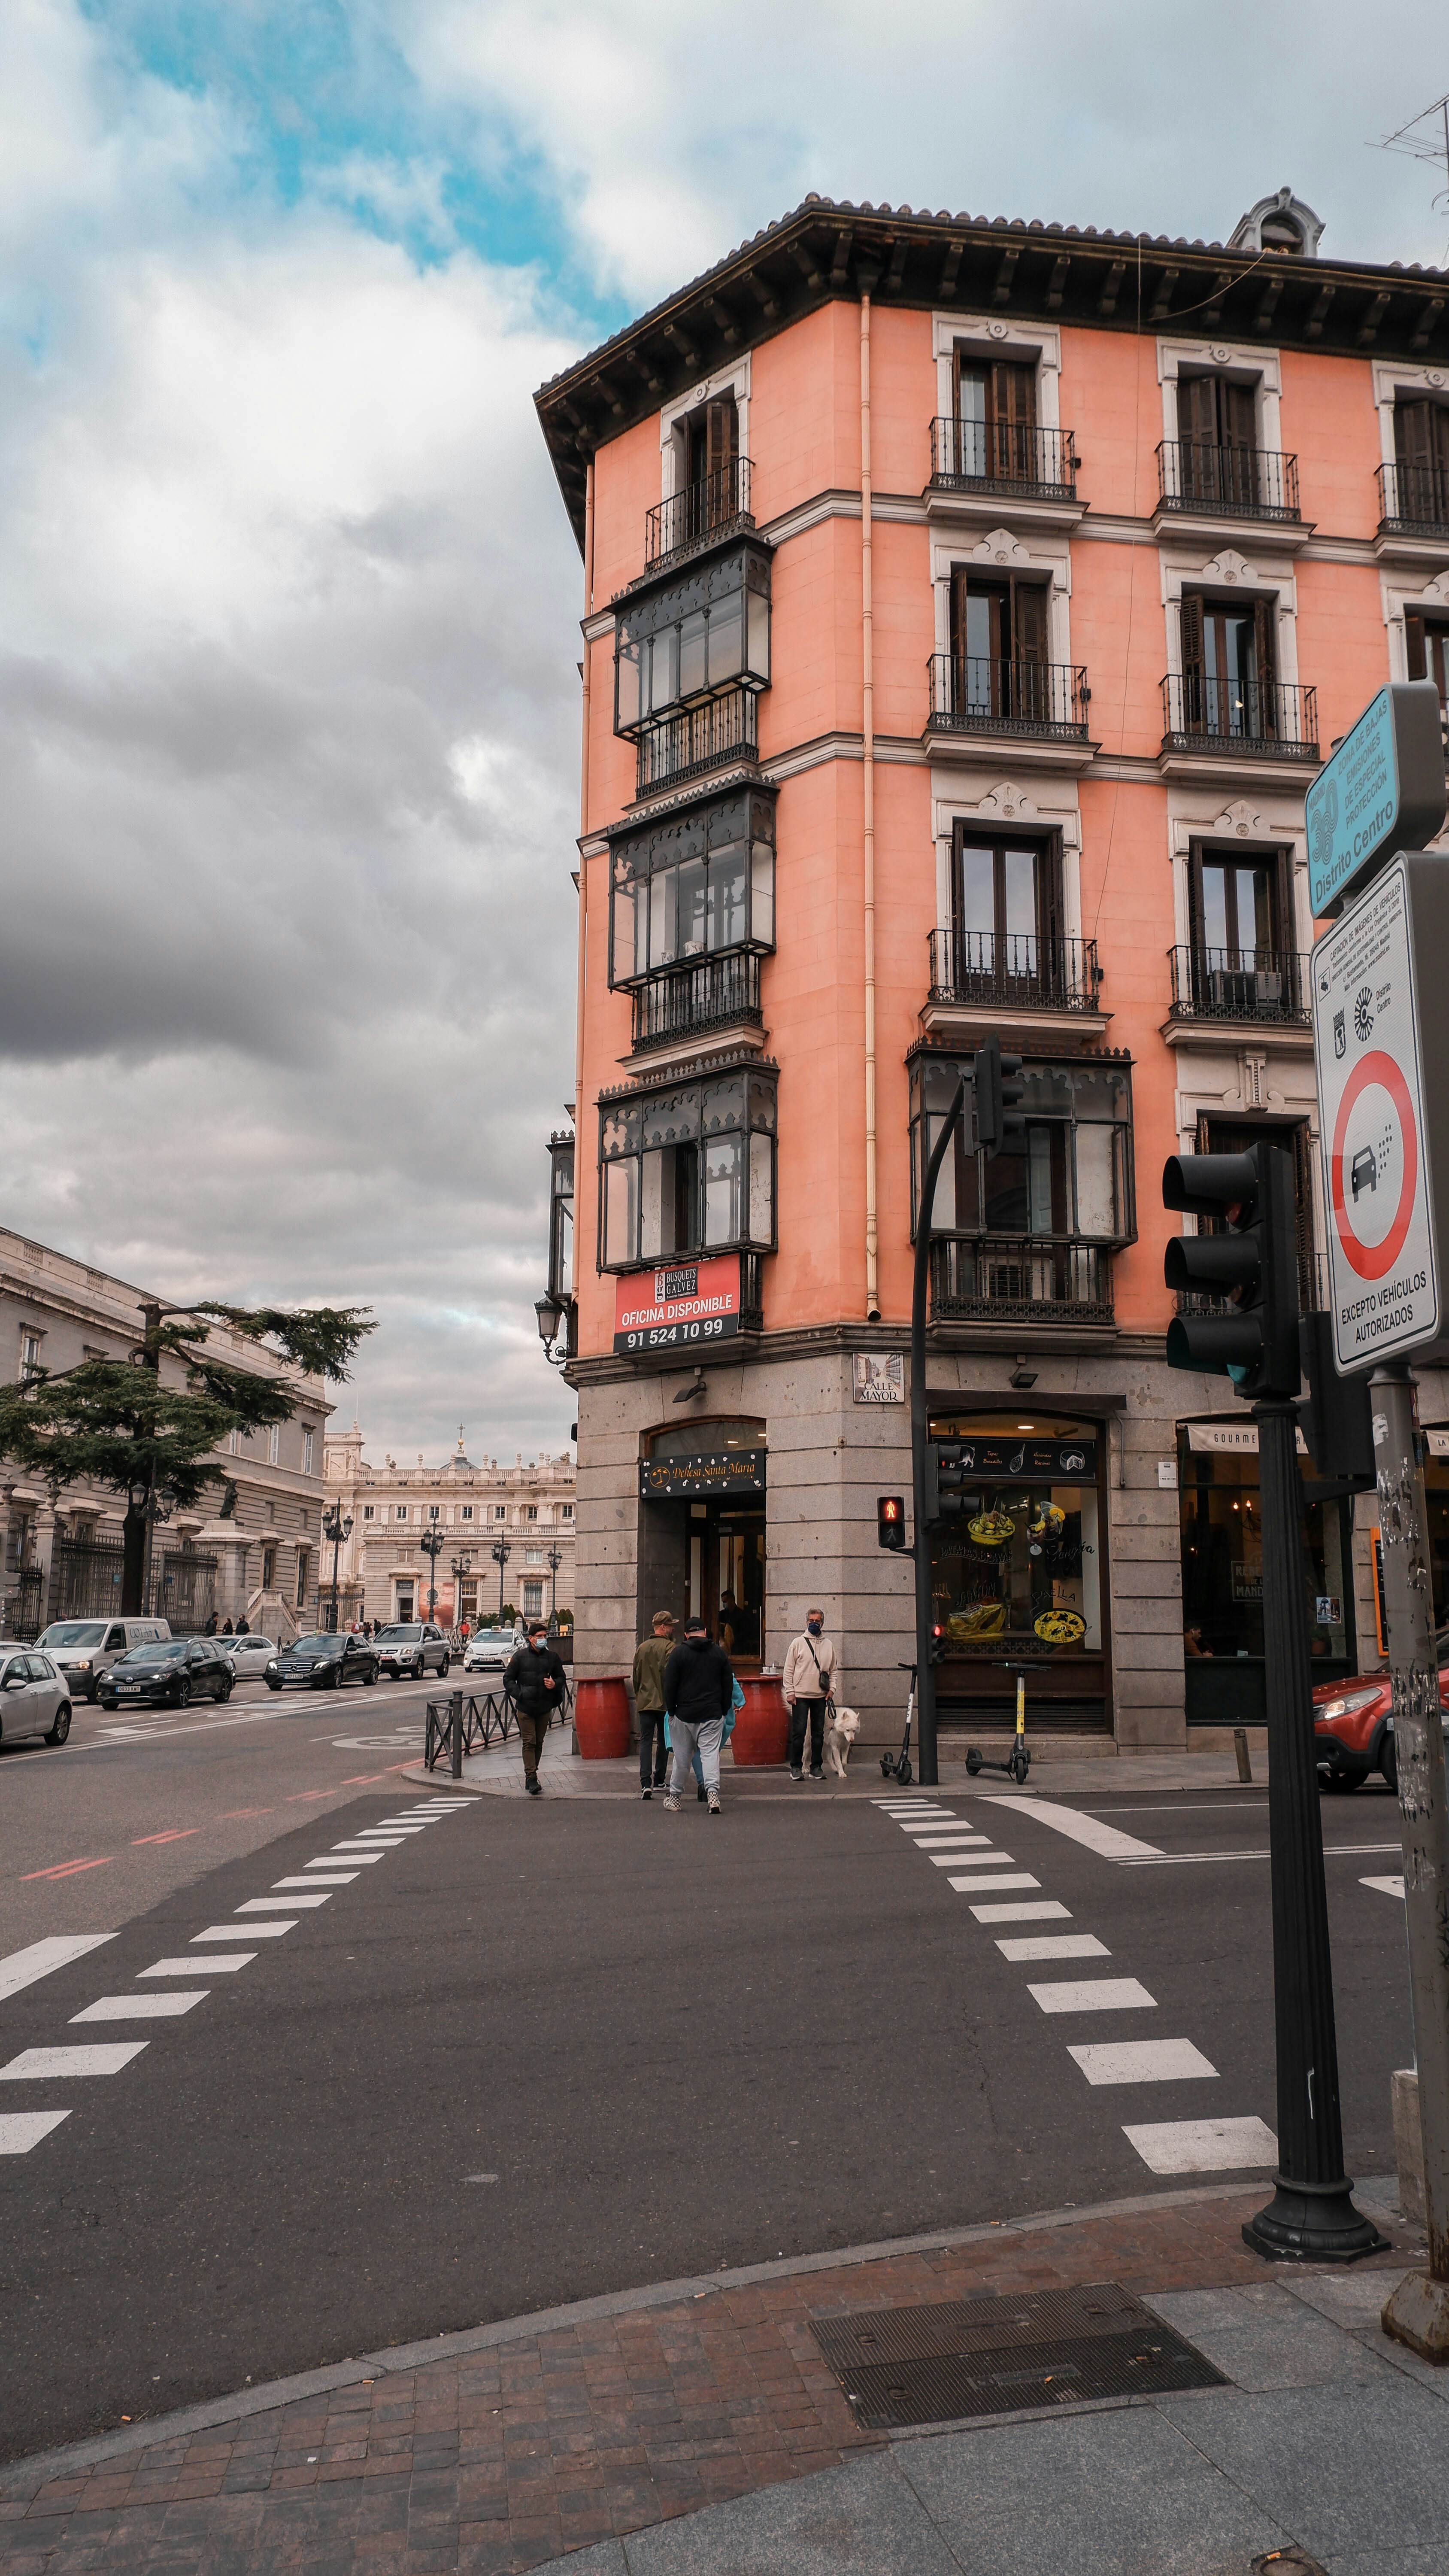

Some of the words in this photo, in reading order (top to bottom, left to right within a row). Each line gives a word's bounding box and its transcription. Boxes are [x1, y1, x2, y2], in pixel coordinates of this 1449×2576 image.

[1338, 748, 1355, 774] ZONA
[1355, 735, 1364, 753] DE
[1366, 699, 1387, 738] BAJAS
[1346, 732, 1381, 786] EMISIONES
[1344, 791, 1354, 811] DE
[1355, 750, 1386, 799] ESPECIAL
[1309, 782, 1325, 814] MADRID
[1346, 768, 1387, 830] PROTECCIÓN
[1316, 856, 1352, 904] Distrito
[1353, 800, 1393, 857] Centro
[1330, 936, 1348, 961] CAPTACIÓN
[1349, 930, 1354, 943] DE
[1355, 911, 1372, 937] IMÁGENES
[1373, 904, 1379, 917] DE
[1379, 881, 1401, 911] VEHÍCULOS
[1353, 953, 1356, 961] DE
[1377, 921, 1388, 937] CONTROL
[1379, 932, 1390, 947] Madrid
[1376, 982, 1391, 1001] Distrito
[1377, 997, 1391, 1015] Centro
[667, 1268, 696, 1283] BUSQUETS
[667, 1280, 696, 1294] GALVEZ
[622, 1306, 664, 1327] OFICINA
[667, 1294, 732, 1319] DISPONIBLE
[1341, 1294, 1376, 1325] EXCEPTO
[1377, 1270, 1427, 1307] VEHÍCULOS
[627, 1332, 644, 1348] 91
[649, 1326, 677, 1345] 524
[682, 1323, 699, 1339] 10
[704, 1318, 723, 1336] 99
[1355, 1304, 1413, 1344] AUTORIZADOS
[861, 1391, 900, 1402] MAYOR
[864, 1382, 894, 1391] CALLE
[1214, 1434, 1256, 1443] GOURME
[673, 1466, 701, 1478] Dehesa
[702, 1465, 726, 1477] Santa
